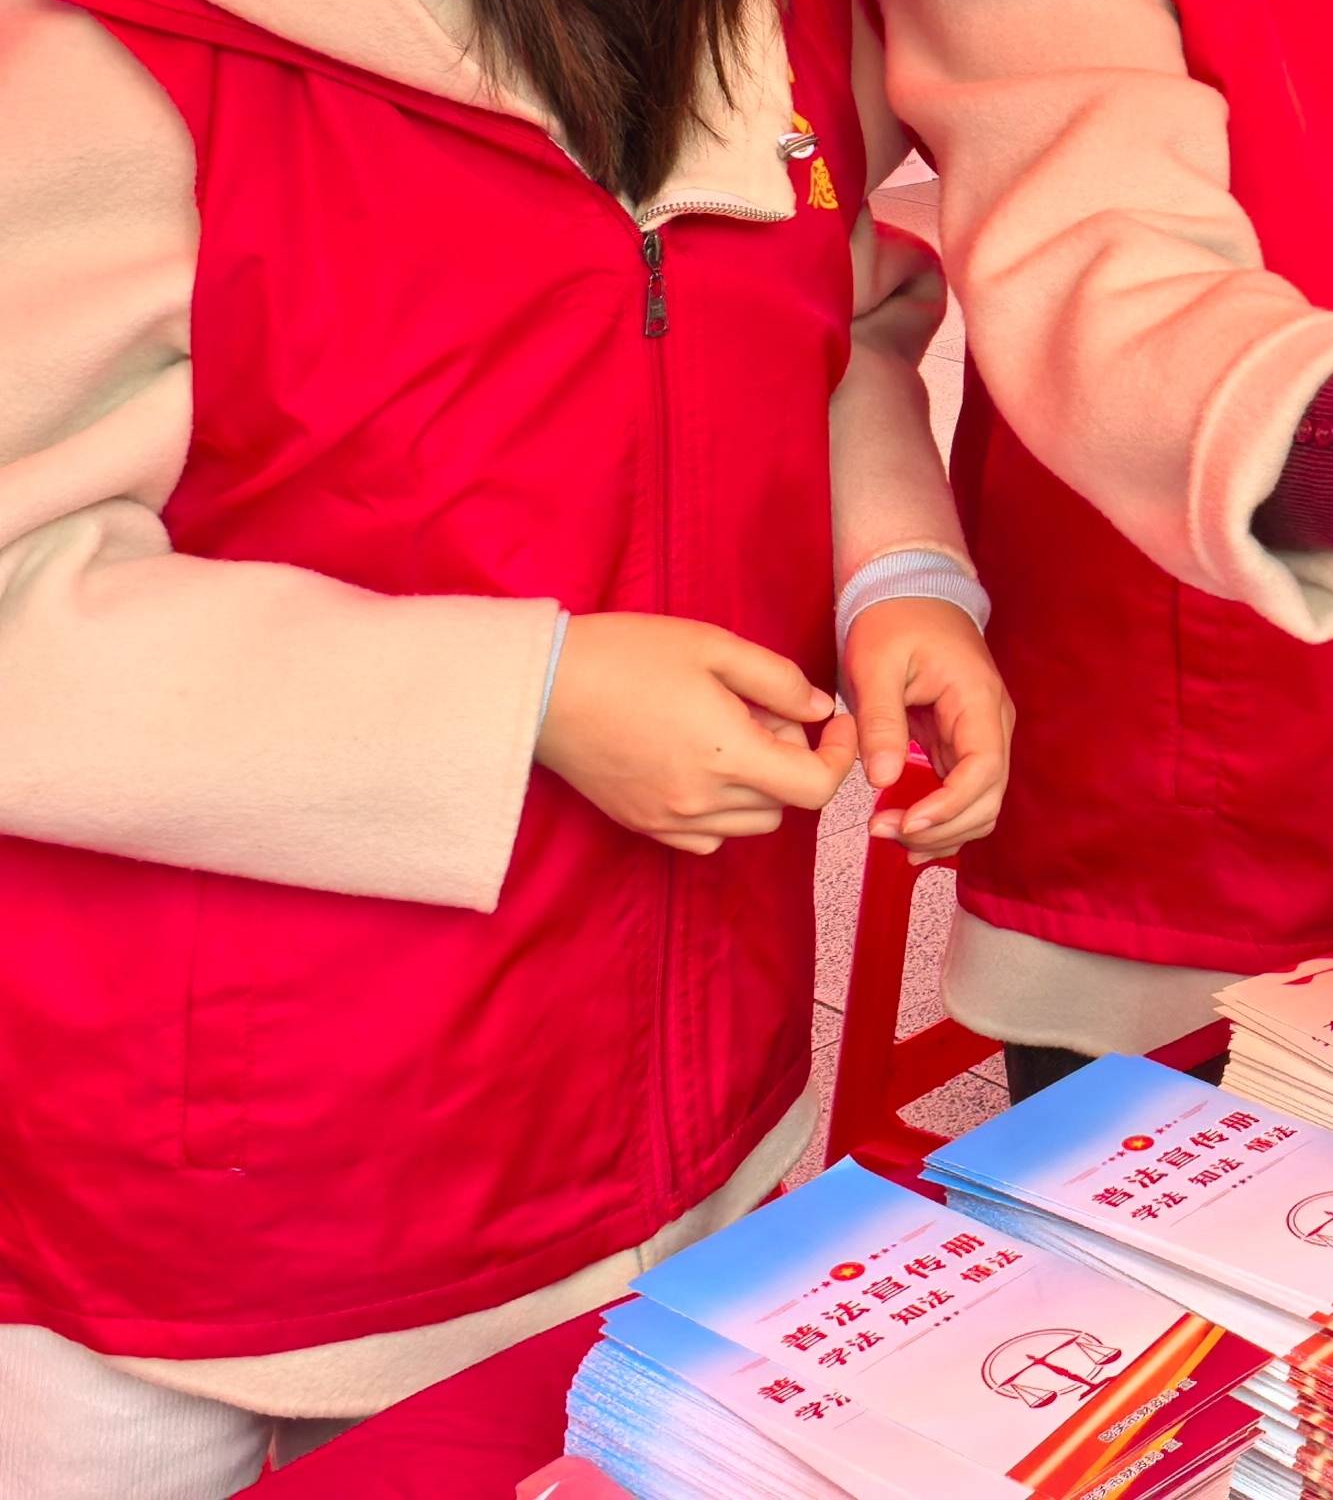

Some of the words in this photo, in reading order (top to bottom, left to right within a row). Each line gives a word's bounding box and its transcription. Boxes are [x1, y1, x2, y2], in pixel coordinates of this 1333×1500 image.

[1091, 1110, 1261, 1209] 普法宣传册
[1130, 1190, 1189, 1221] 学法
[1188, 1156, 1245, 1188] 知法
[1242, 1124, 1299, 1154] 懂法
[780, 1232, 985, 1352] 普法宣传册
[817, 1329, 886, 1369] 学法
[888, 1288, 956, 1326] 知法
[958, 1248, 1024, 1283] 懂法
[757, 1376, 806, 1404] 普
